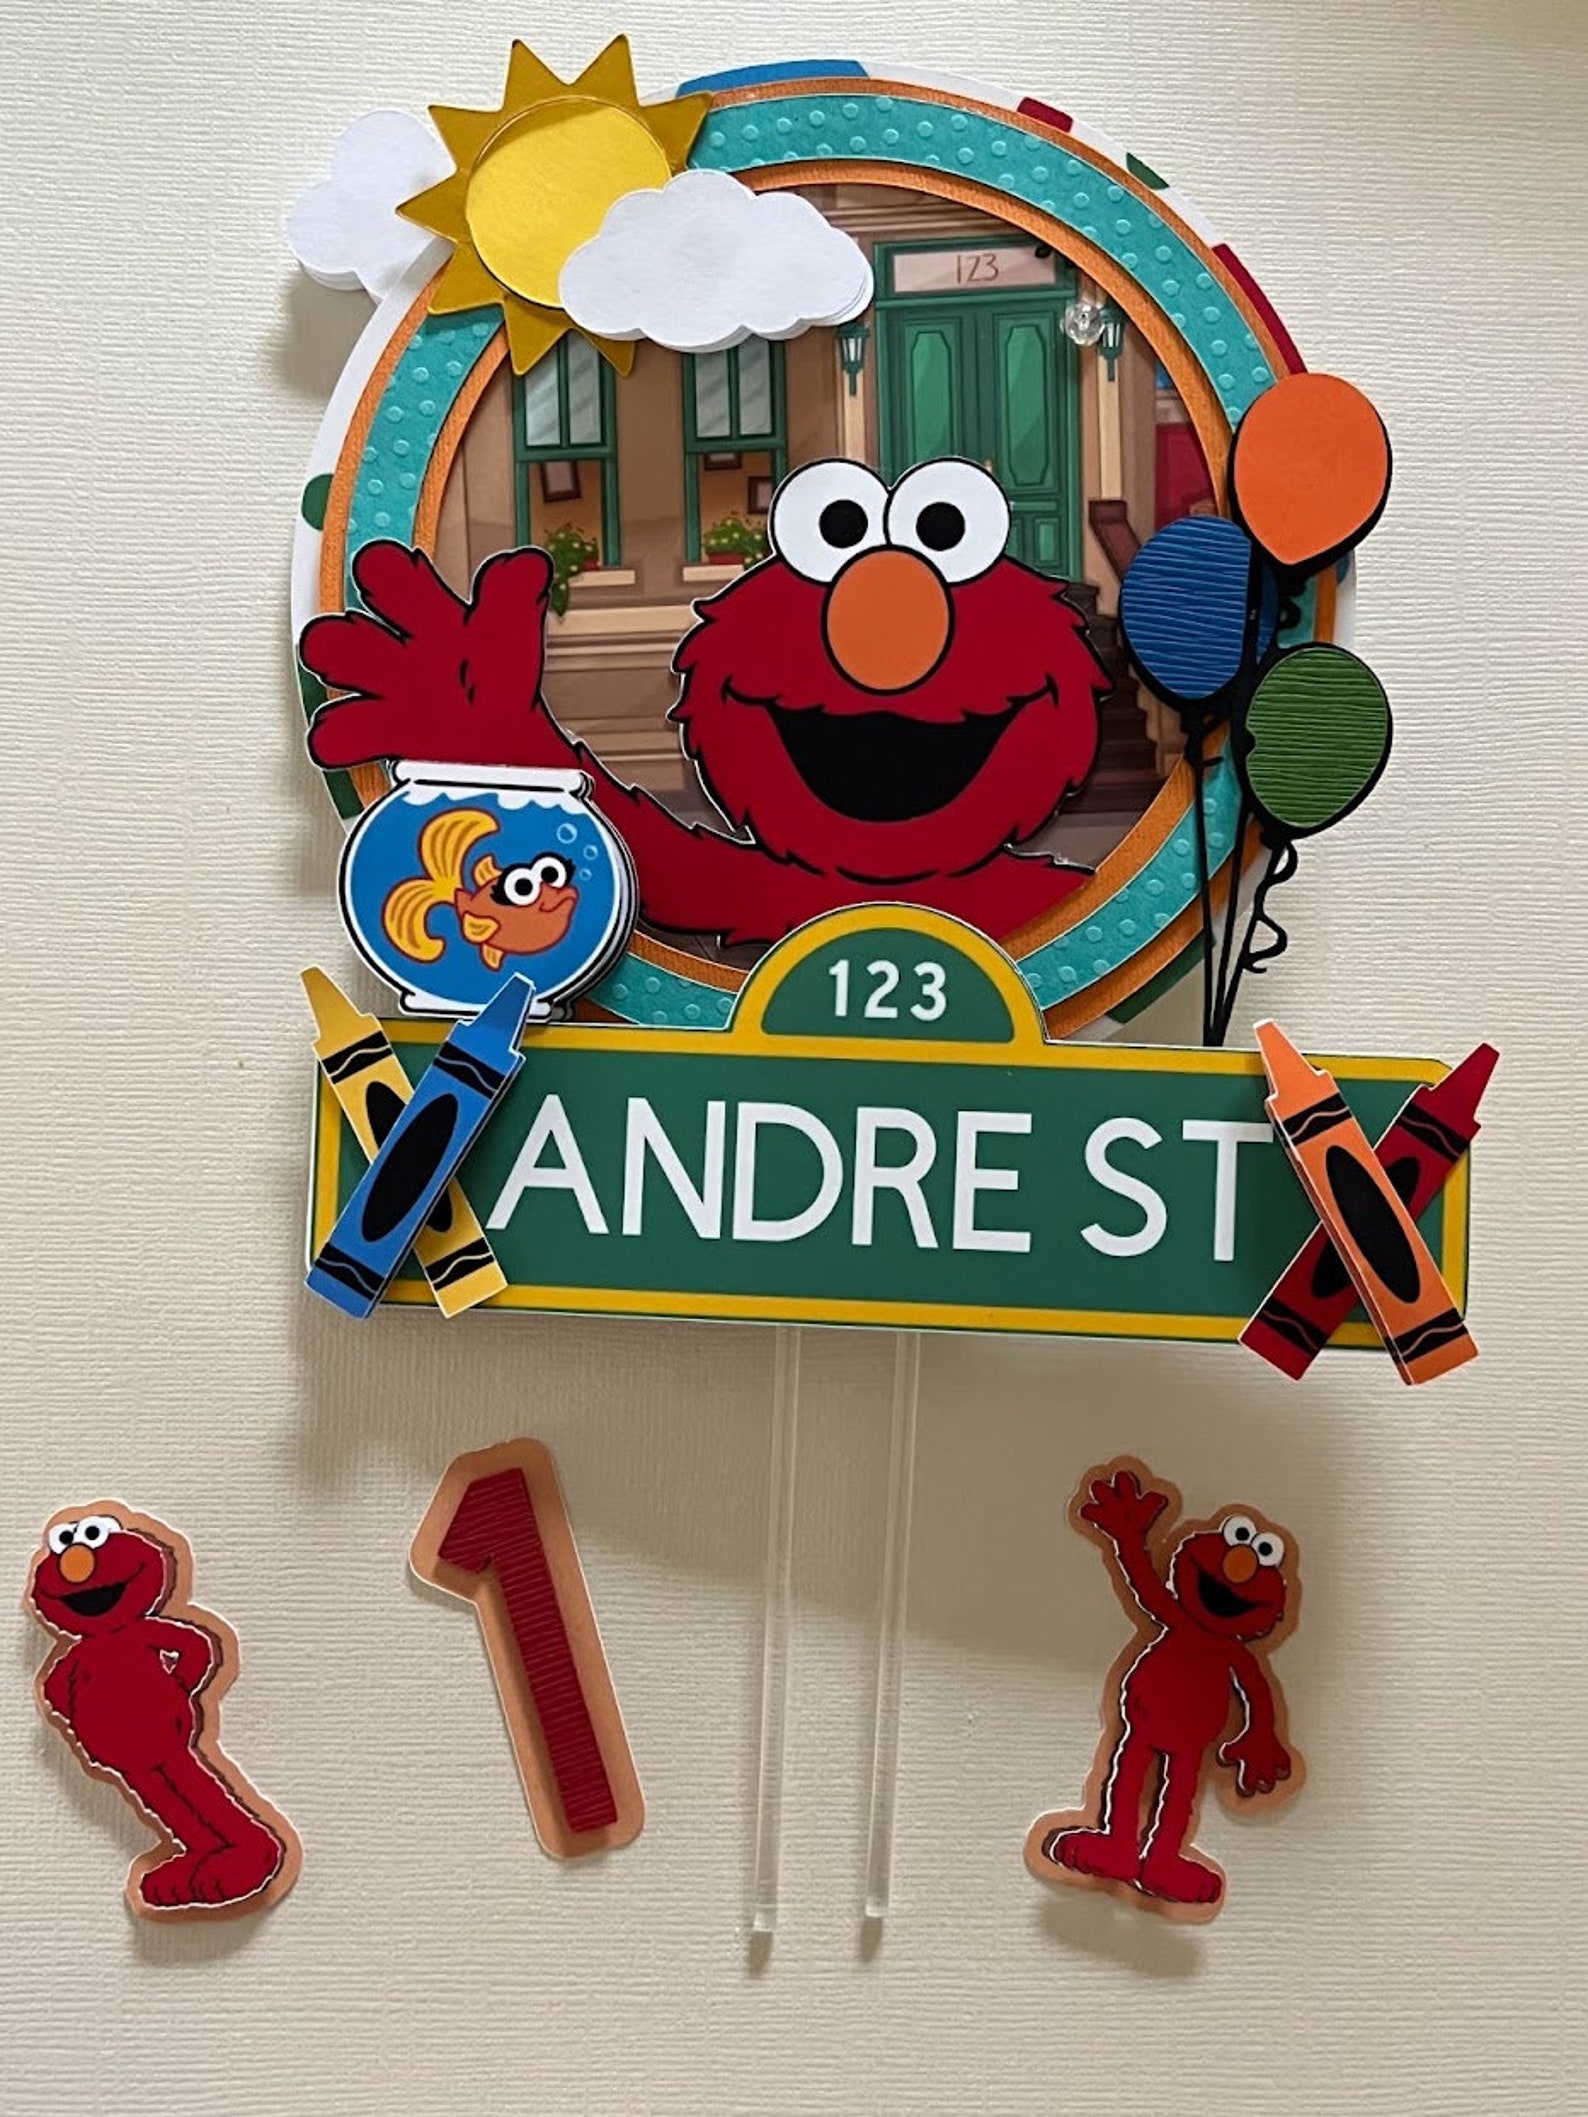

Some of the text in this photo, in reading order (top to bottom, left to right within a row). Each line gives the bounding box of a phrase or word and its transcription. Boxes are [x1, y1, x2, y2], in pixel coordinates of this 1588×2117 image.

[957, 252, 999, 284] 123
[829, 959, 946, 1021] 123
[486, 1094, 1274, 1262] ANDRE ST
[438, 1467, 618, 1833] 1
